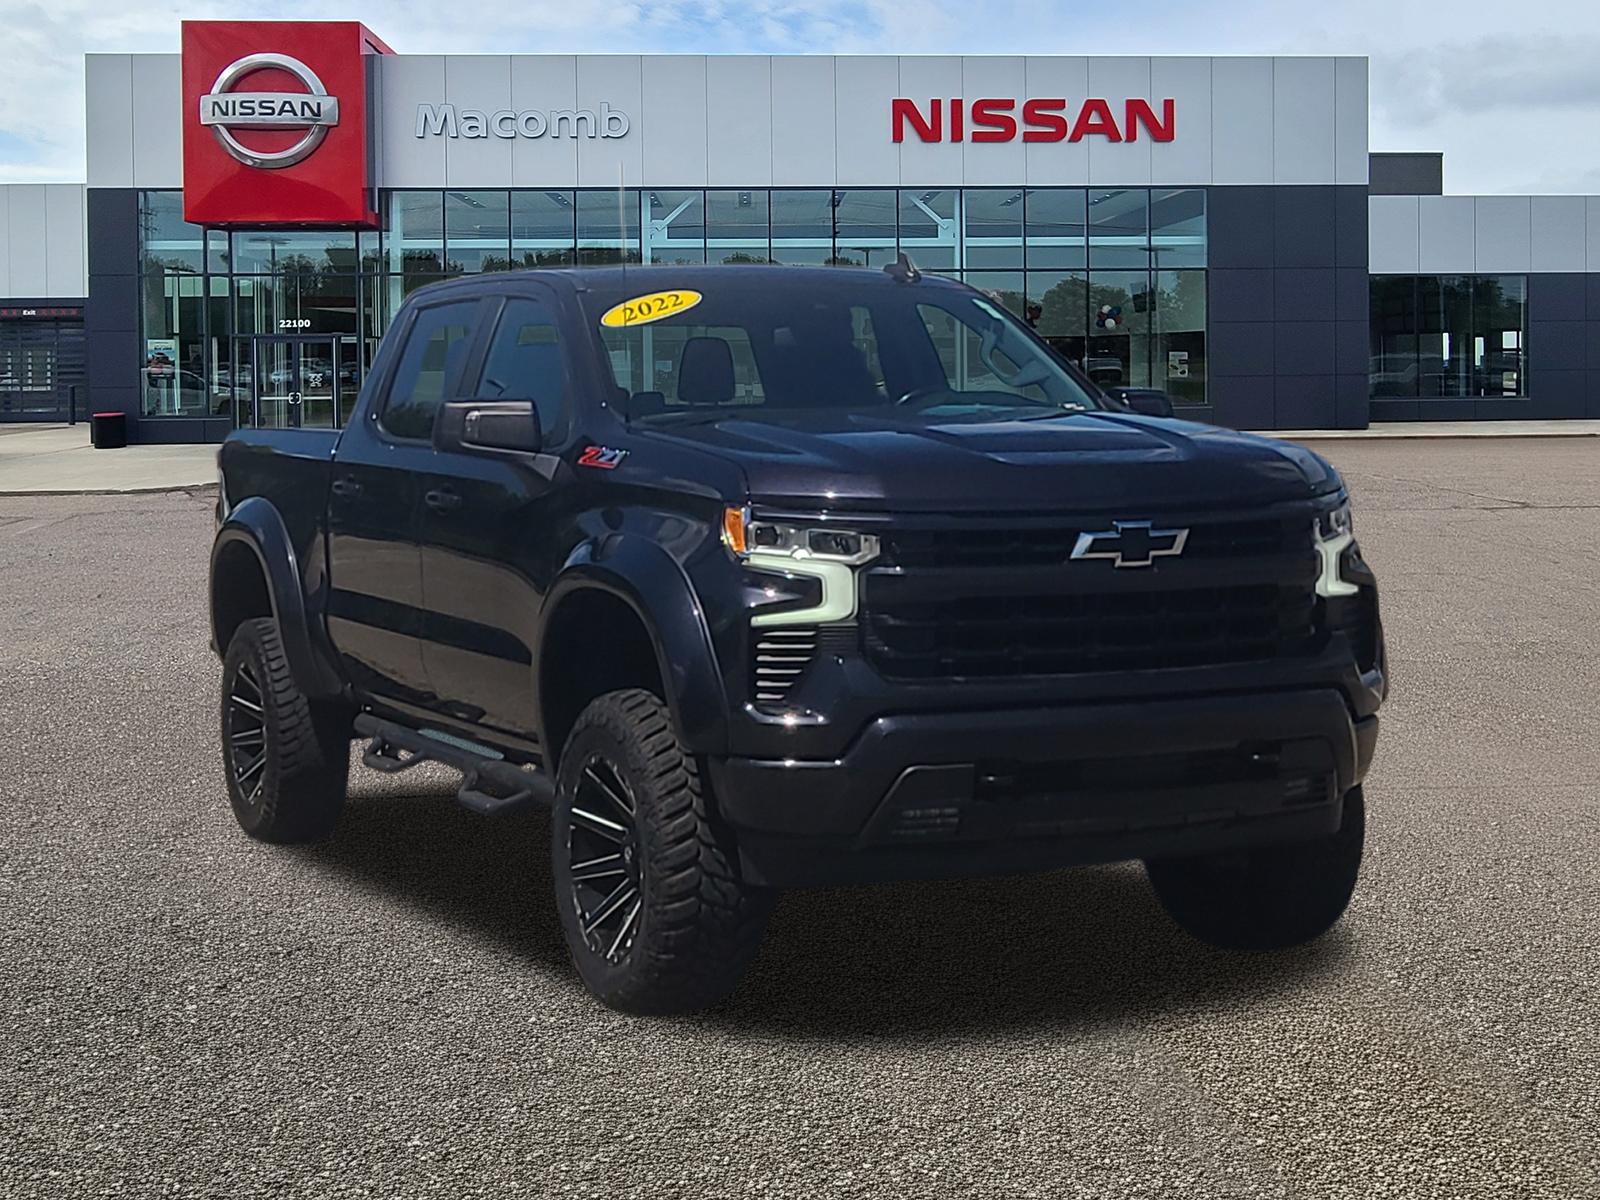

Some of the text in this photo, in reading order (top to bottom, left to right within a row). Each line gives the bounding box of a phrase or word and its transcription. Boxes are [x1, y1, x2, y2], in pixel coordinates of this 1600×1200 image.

[212, 100, 322, 117] NISSAN
[415, 102, 629, 138] Macomb
[892, 98, 1175, 143] NISSAN
[623, 294, 684, 322] 2022
[279, 319, 311, 328] 22100
